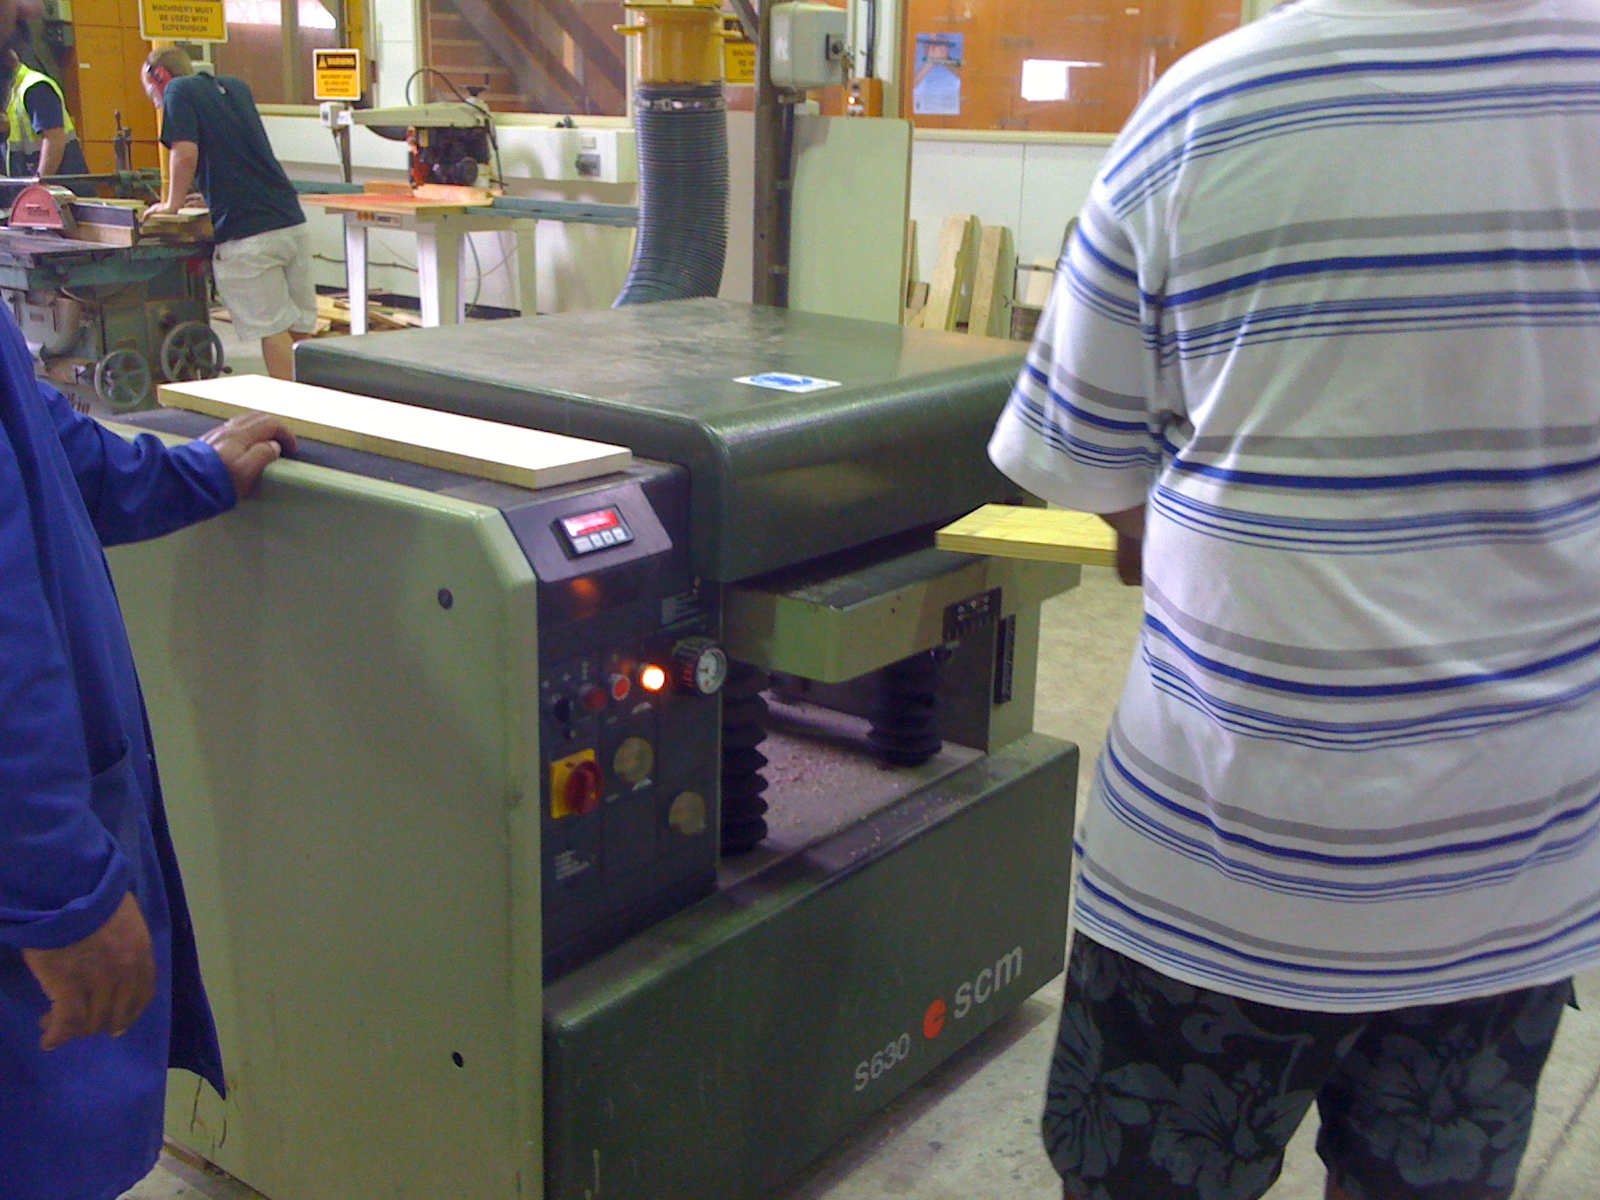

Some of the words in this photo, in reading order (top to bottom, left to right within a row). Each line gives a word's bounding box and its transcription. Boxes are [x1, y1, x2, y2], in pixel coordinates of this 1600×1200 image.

[152, 4, 194, 13] MACHINERY
[195, 6, 213, 14] MUST
[159, 13, 168, 21] BE
[170, 14, 190, 22] USED
[191, 15, 209, 23] WITH
[161, 23, 208, 32] SUPERVISION
[854, 1032, 911, 1092] S630
[953, 946, 1023, 1020] scm
